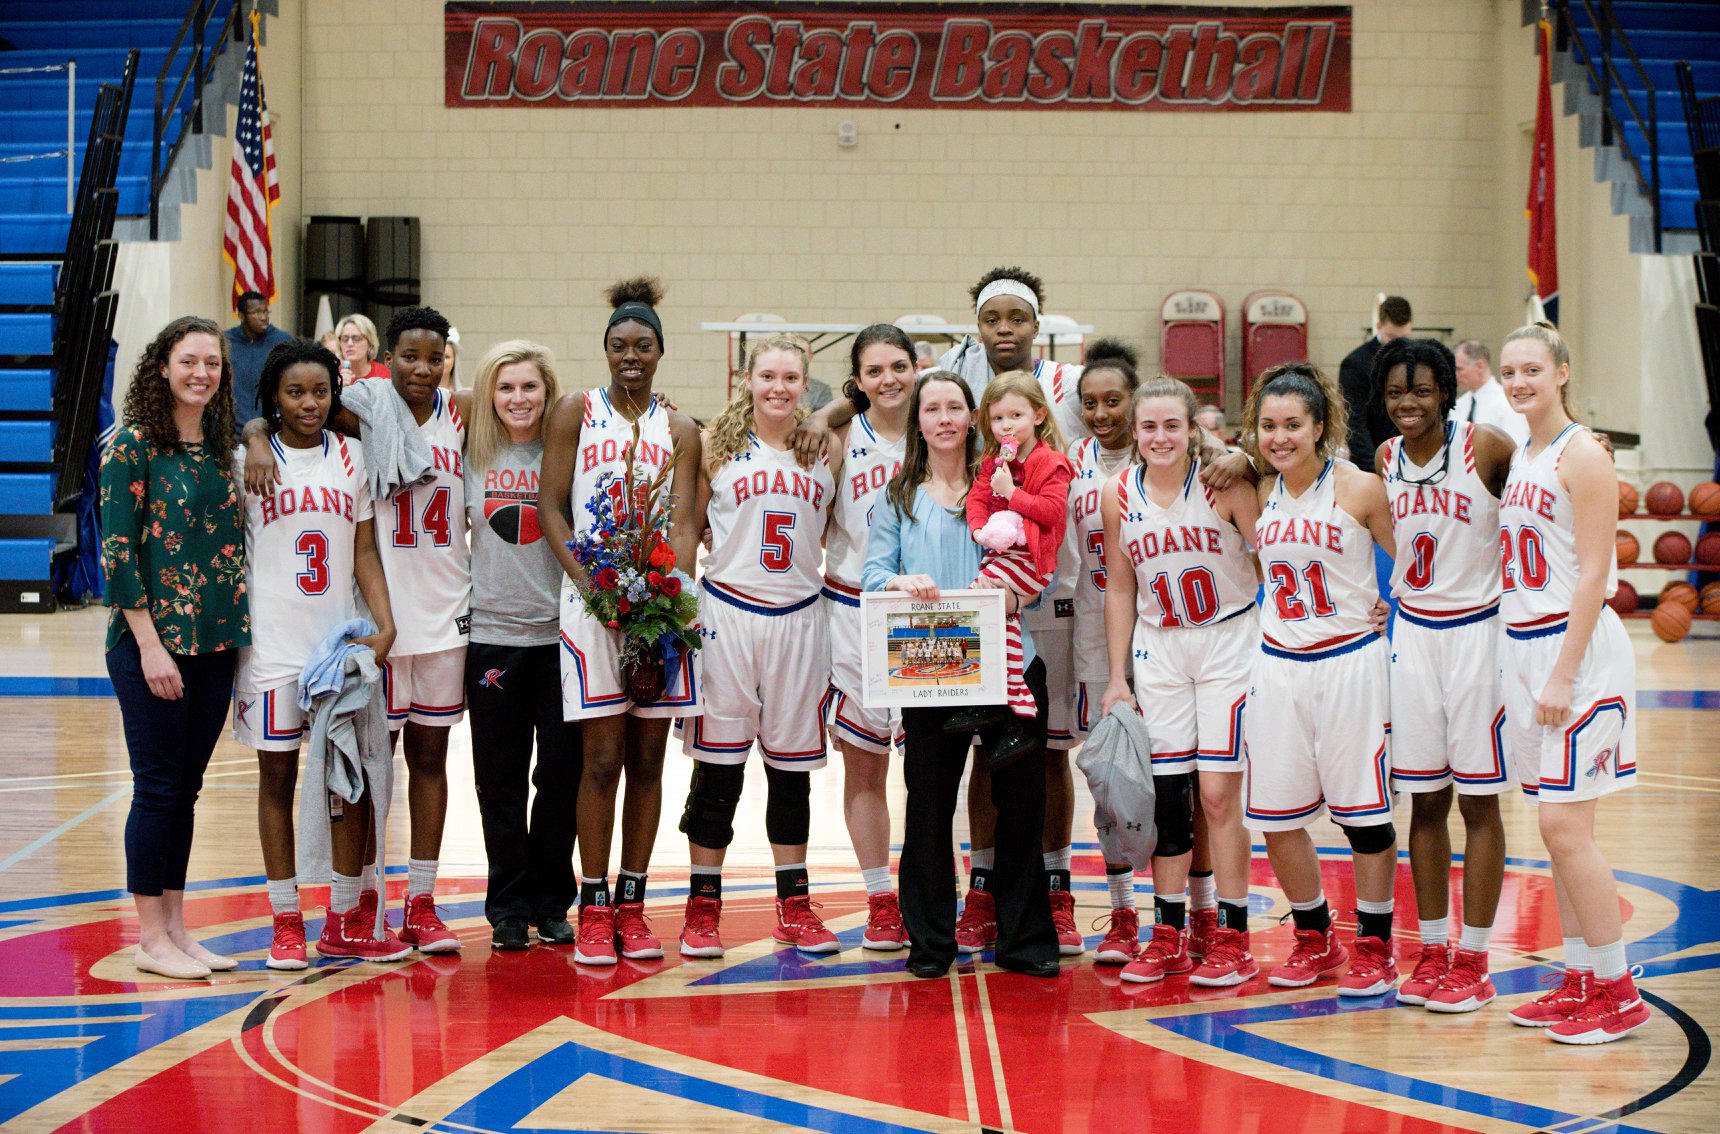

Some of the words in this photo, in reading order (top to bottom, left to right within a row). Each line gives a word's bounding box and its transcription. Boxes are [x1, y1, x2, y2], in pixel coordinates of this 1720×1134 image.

[461, 17, 704, 101] Roane
[716, 15, 920, 102] State
[930, 18, 1335, 106] Basketball
[259, 485, 355, 528] ROANE
[484, 468, 540, 491] ROAN
[733, 469, 824, 512] ROANE
[392, 486, 451, 548] 14
[760, 510, 797, 573] 5
[1126, 525, 1224, 568] ROANE
[295, 530, 331, 596] 3
[1268, 560, 1338, 622] 21
[1403, 531, 1438, 592] 0
[911, 602, 935, 612] ROANE
[938, 601, 961, 611] STATE
[1149, 565, 1220, 628] 10
[912, 689, 933, 699] LADY
[937, 687, 969, 697] RAIDERS
